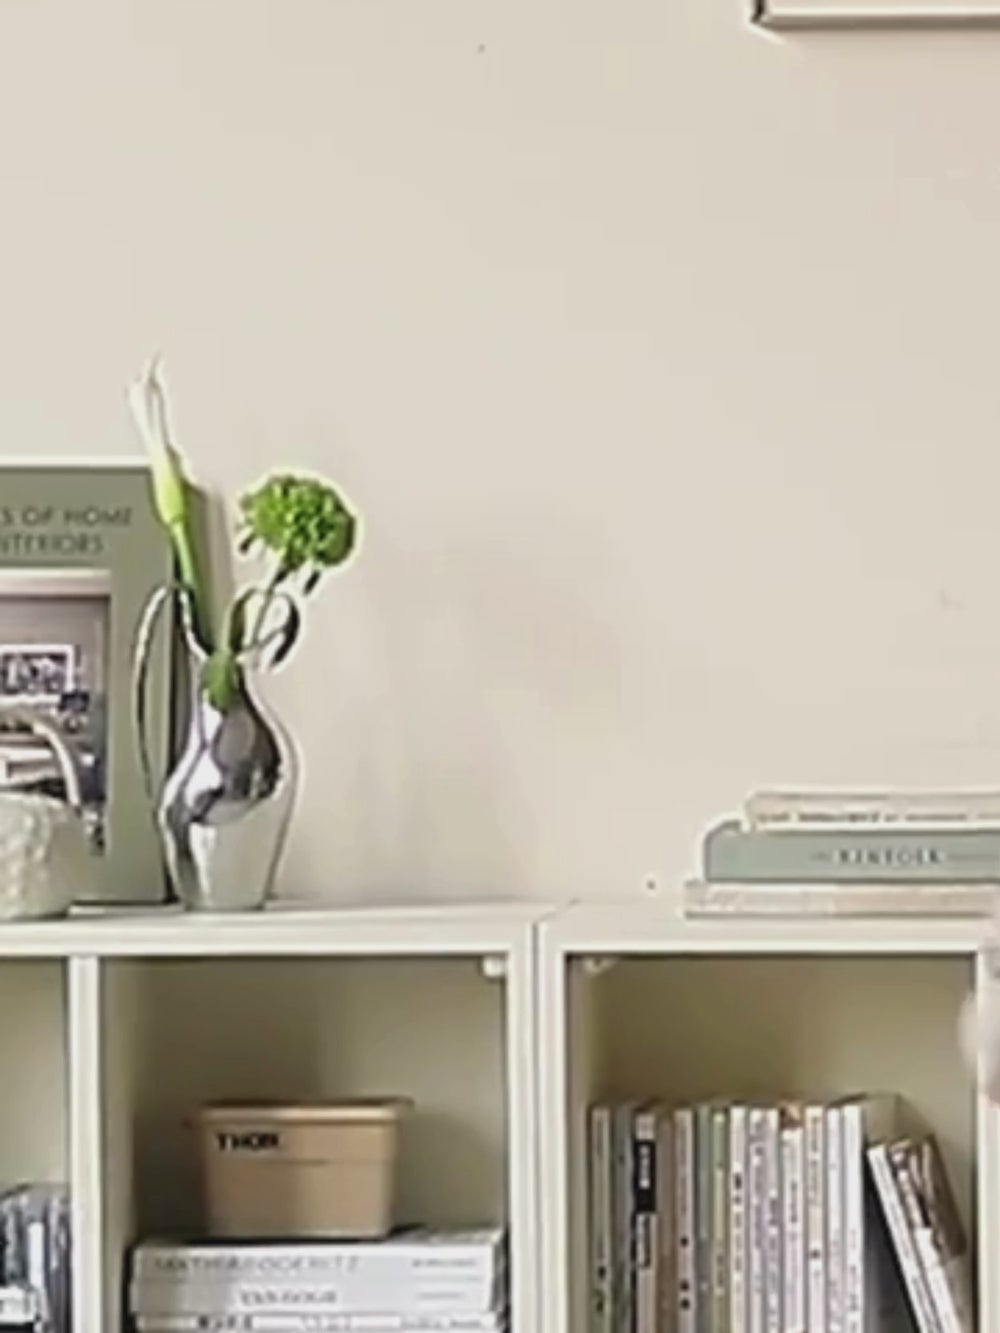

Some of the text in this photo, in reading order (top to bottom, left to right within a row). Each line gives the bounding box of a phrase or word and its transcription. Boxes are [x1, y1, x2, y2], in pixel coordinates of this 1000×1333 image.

[21, 505, 54, 527] OF
[63, 505, 133, 527] HOME
[217, 1131, 280, 1151] THOR
